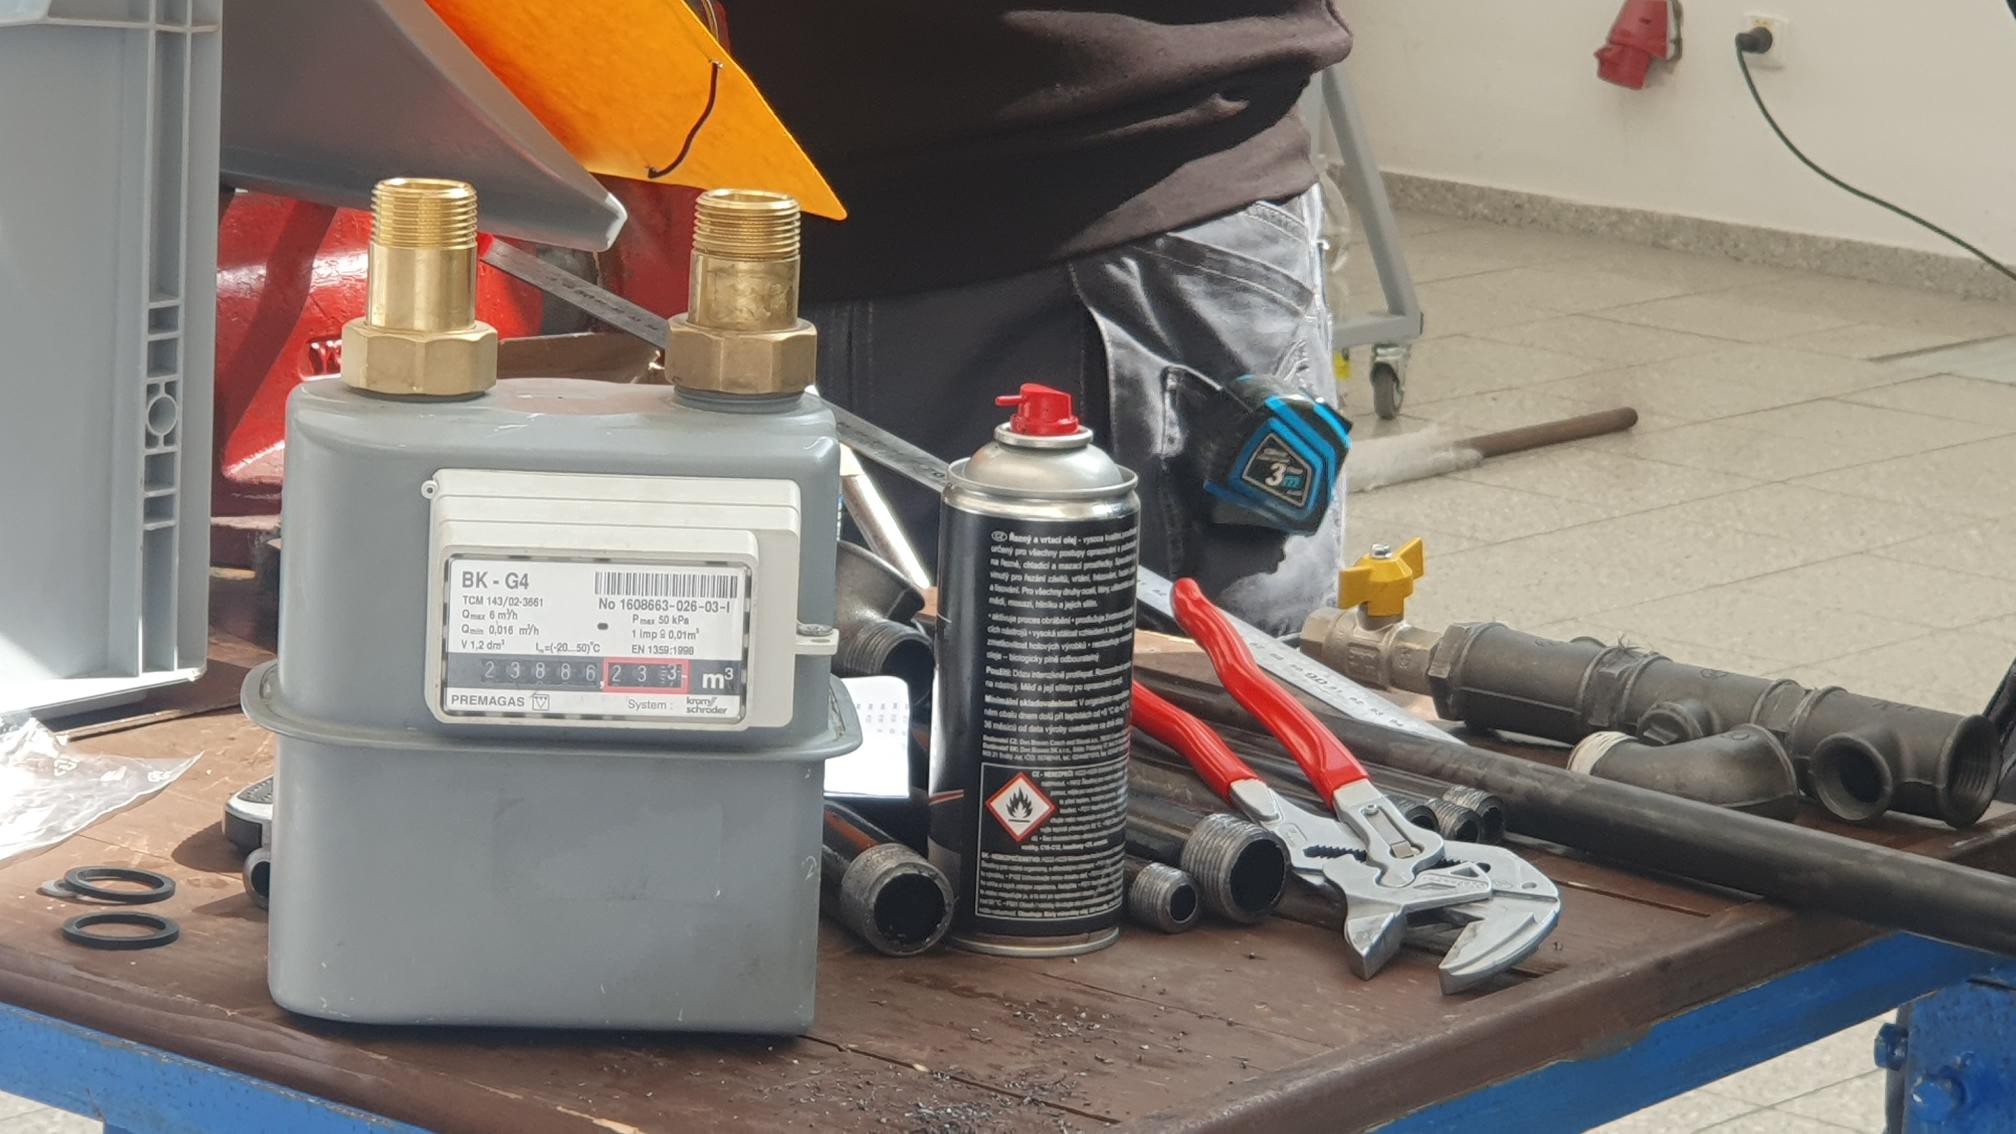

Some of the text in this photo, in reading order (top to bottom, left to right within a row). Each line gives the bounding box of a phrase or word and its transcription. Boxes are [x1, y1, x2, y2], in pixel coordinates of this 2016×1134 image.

[1265, 463, 1287, 486] 3
[462, 571, 488, 589] BK
[505, 572, 529, 590] G4
[463, 595, 484, 606] TCM
[599, 598, 616, 610] No
[489, 610, 496, 620] 6
[658, 615, 670, 625] 50
[671, 614, 690, 625] kPa
[640, 630, 658, 640] imp
[461, 639, 468, 649] V
[471, 640, 484, 651] 1,2
[631, 644, 645, 655] EN
[451, 694, 525, 707] PREMAGAS
[628, 698, 667, 712] System
